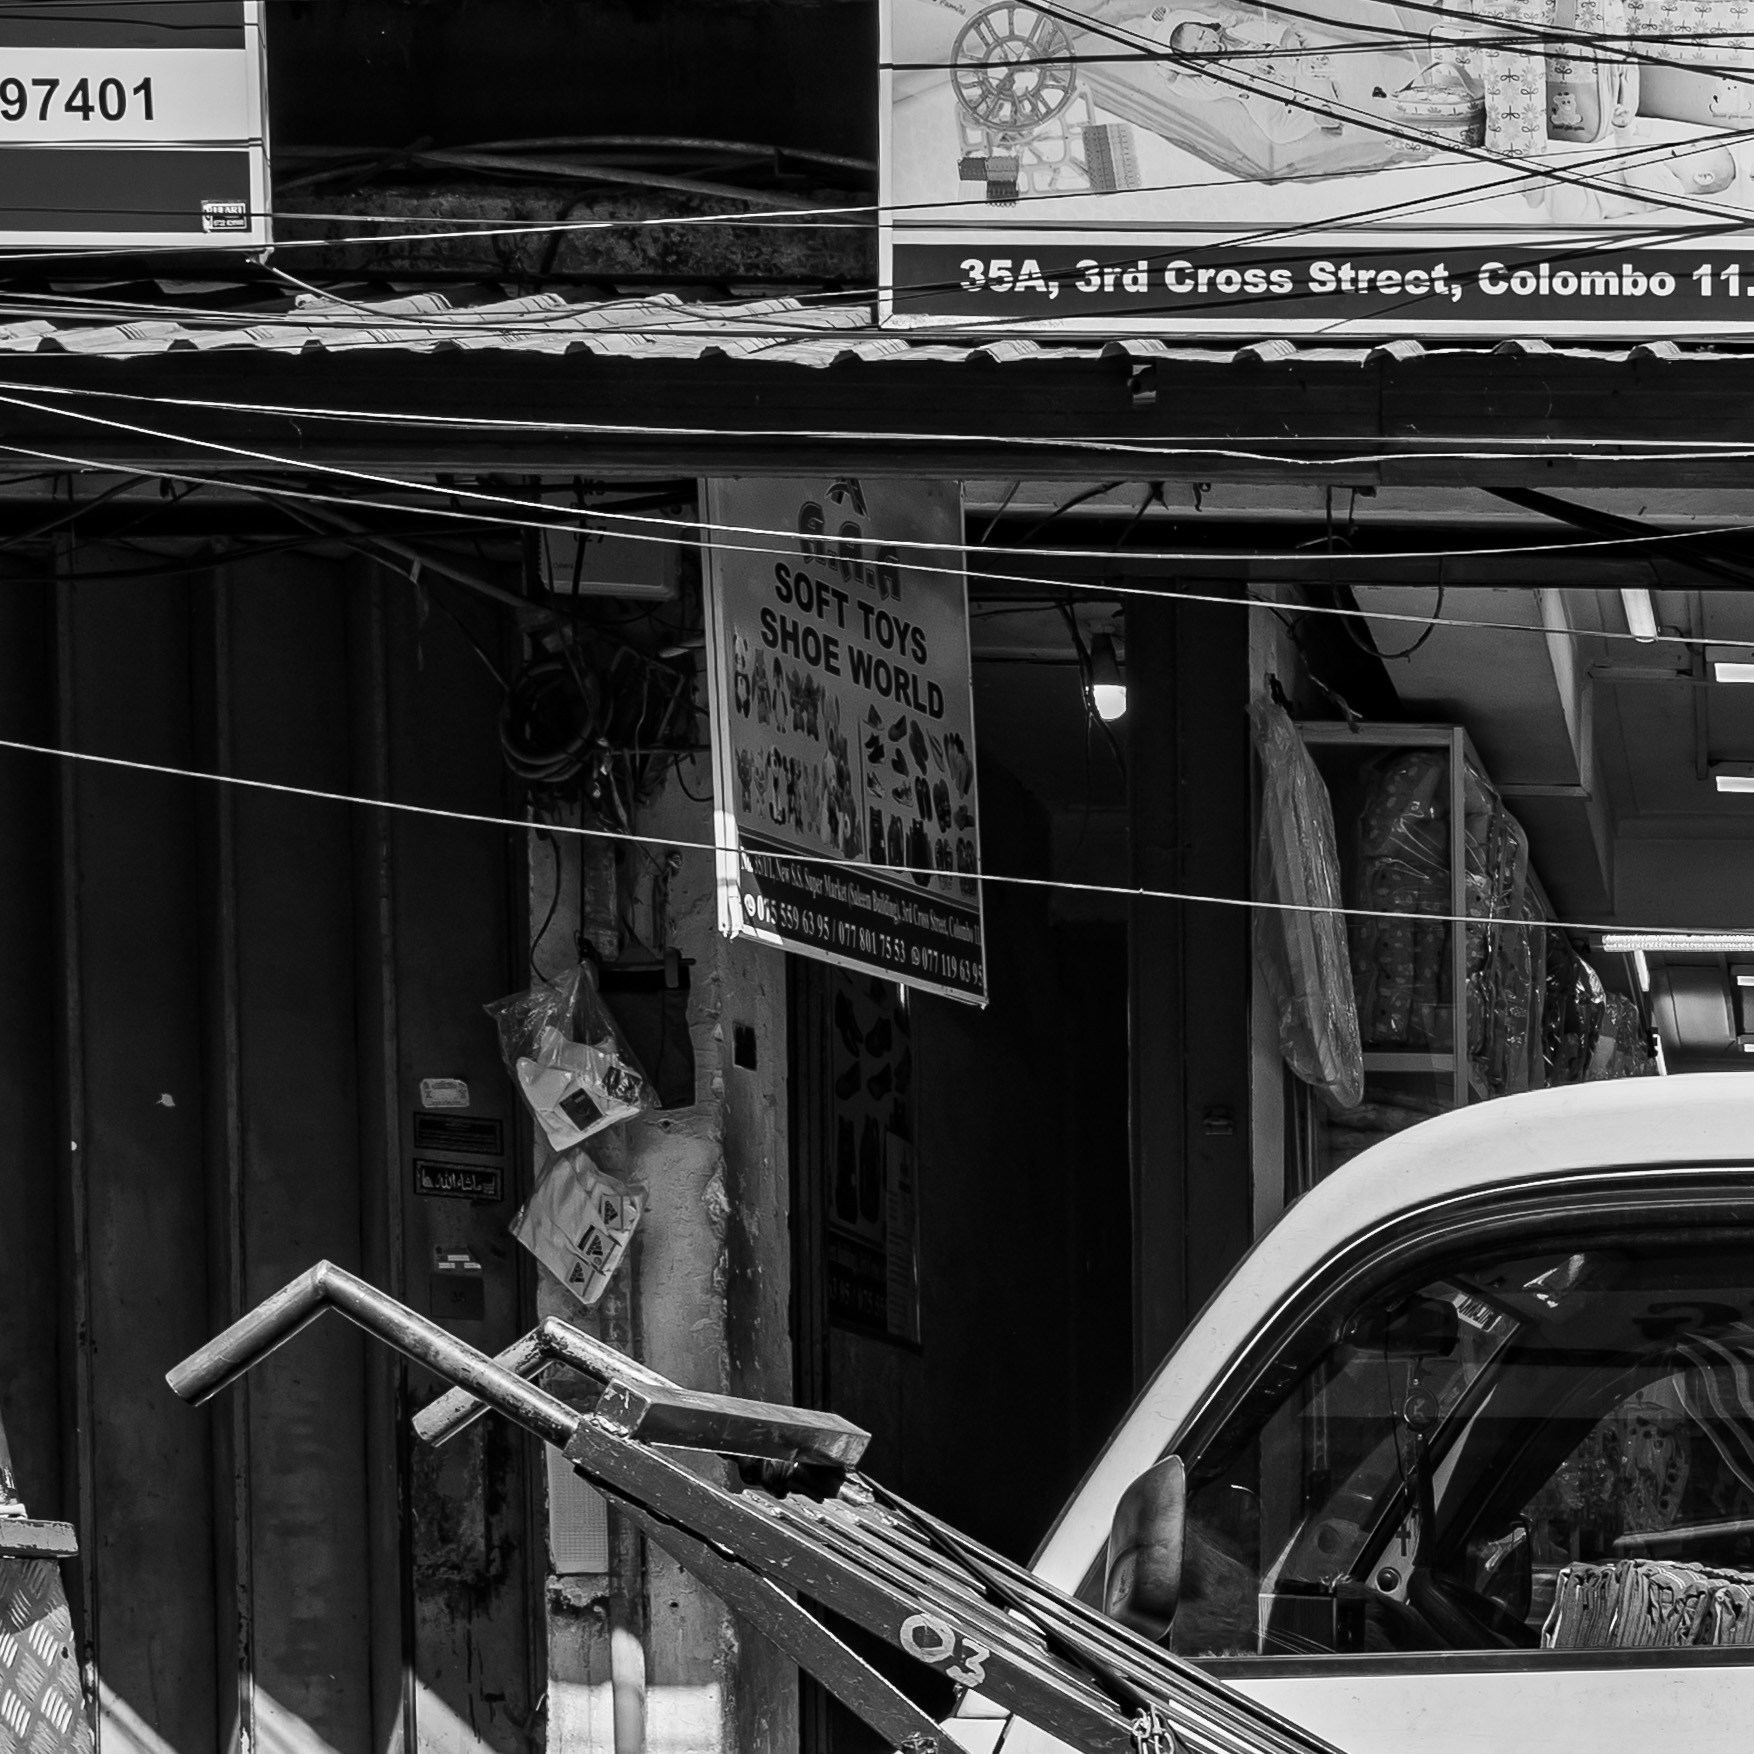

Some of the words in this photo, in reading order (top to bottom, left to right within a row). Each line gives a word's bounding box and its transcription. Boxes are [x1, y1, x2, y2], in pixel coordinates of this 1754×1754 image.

[0, 77, 154, 121] 97401
[960, 258, 1060, 300] 35A,
[1077, 259, 1149, 294] 3rd
[1163, 260, 1294, 295] Cross
[1309, 262, 1463, 303] Street,
[1479, 263, 1677, 298] Colombo
[775, 562, 849, 629] SOFT
[857, 599, 928, 665] TOYS
[760, 606, 842, 677] SHOE
[848, 644, 945, 720] WORLD
[780, 902, 799, 931] 559
[801, 909, 815, 935] 63
[817, 913, 830, 940] 95
[838, 920, 857, 948] 077
[859, 926, 878, 955] 801
[880, 933, 892, 959] 75
[894, 938, 906, 963] 53
[921, 946, 939, 974] 077
[941, 953, 958, 979] 119
[959, 958, 971, 983] 63
